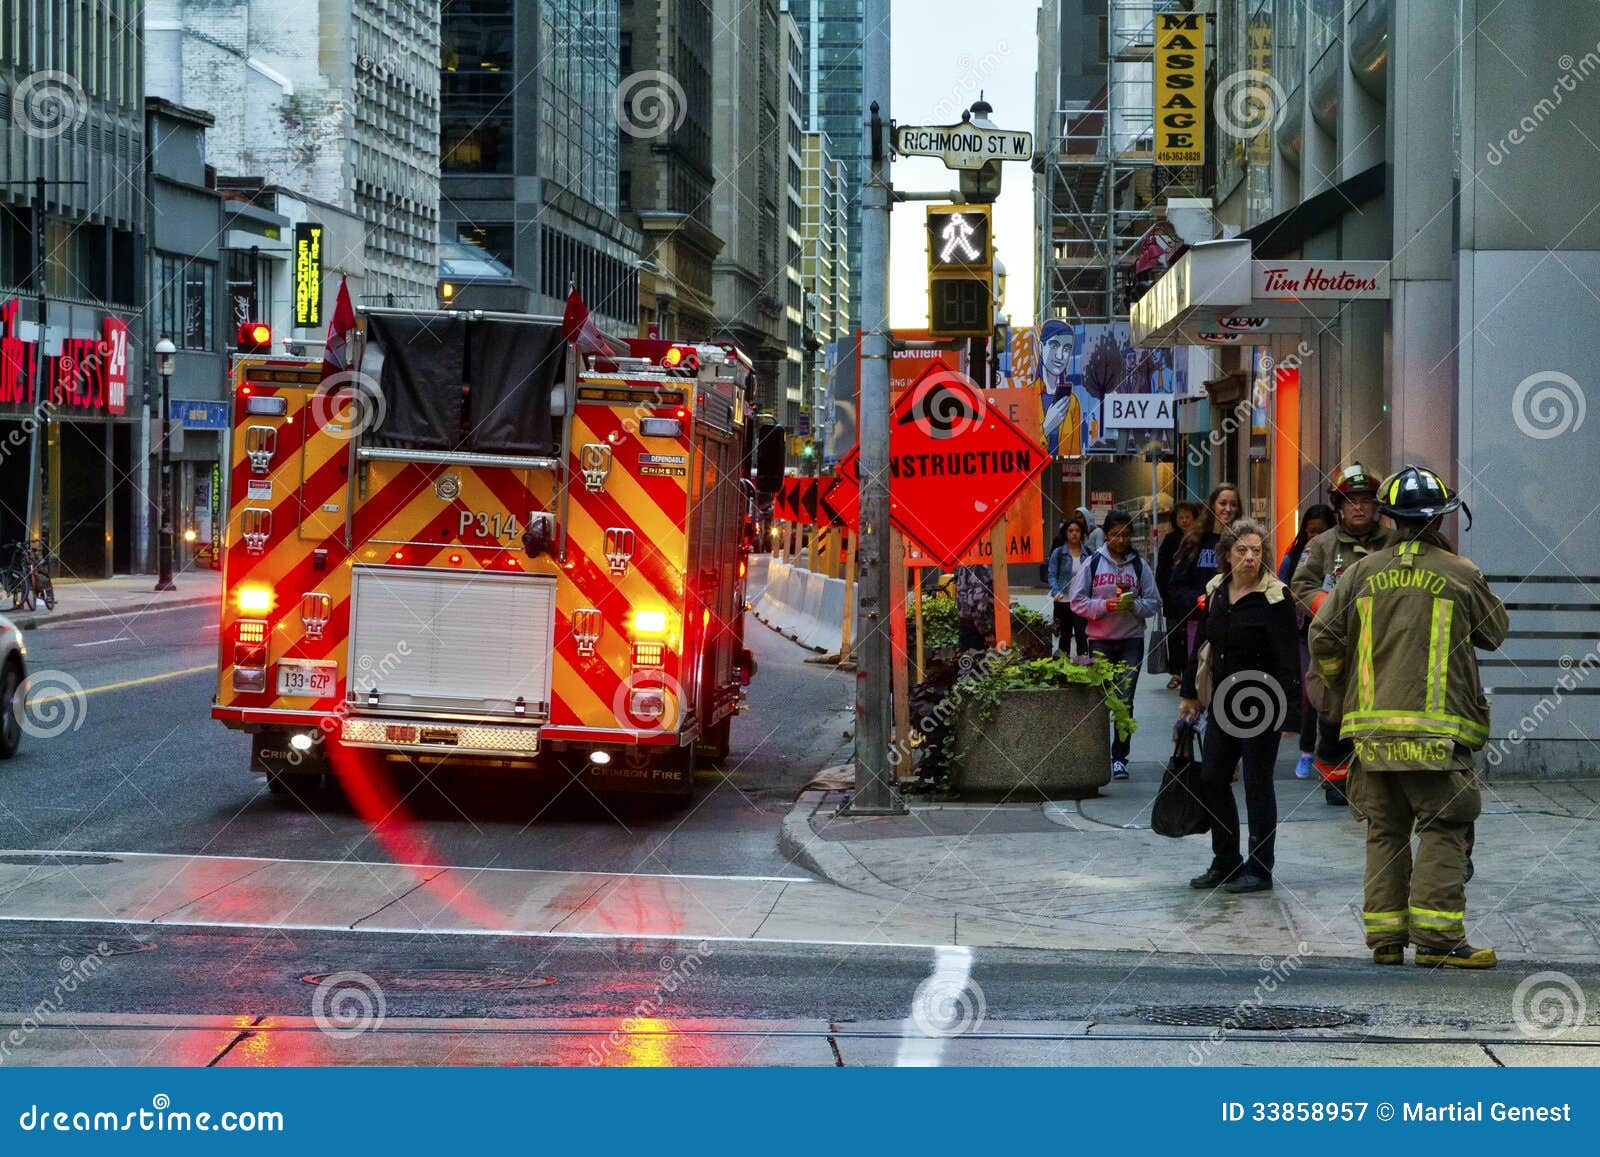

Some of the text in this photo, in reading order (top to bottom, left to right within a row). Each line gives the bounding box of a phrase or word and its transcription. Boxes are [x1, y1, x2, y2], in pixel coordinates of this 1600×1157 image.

[1161, 14, 1199, 149] MASSAGE
[904, 131, 1027, 156] RICHMOND ST. W.
[1157, 151, 1201, 162] 416-362-8828
[297, 240, 308, 323] EXCHANGE
[1264, 267, 1376, 292] Tim Hortons
[109, 329, 126, 376] 24
[1112, 400, 1150, 420] BAY
[651, 455, 685, 464] DEPENDABLE
[854, 450, 1031, 479] NSTRUCTION
[459, 510, 518, 540] P314
[1366, 567, 1447, 595] TORONTO
[1385, 741, 1451, 761] THOMAS
[652, 769, 681, 780] FIRE
